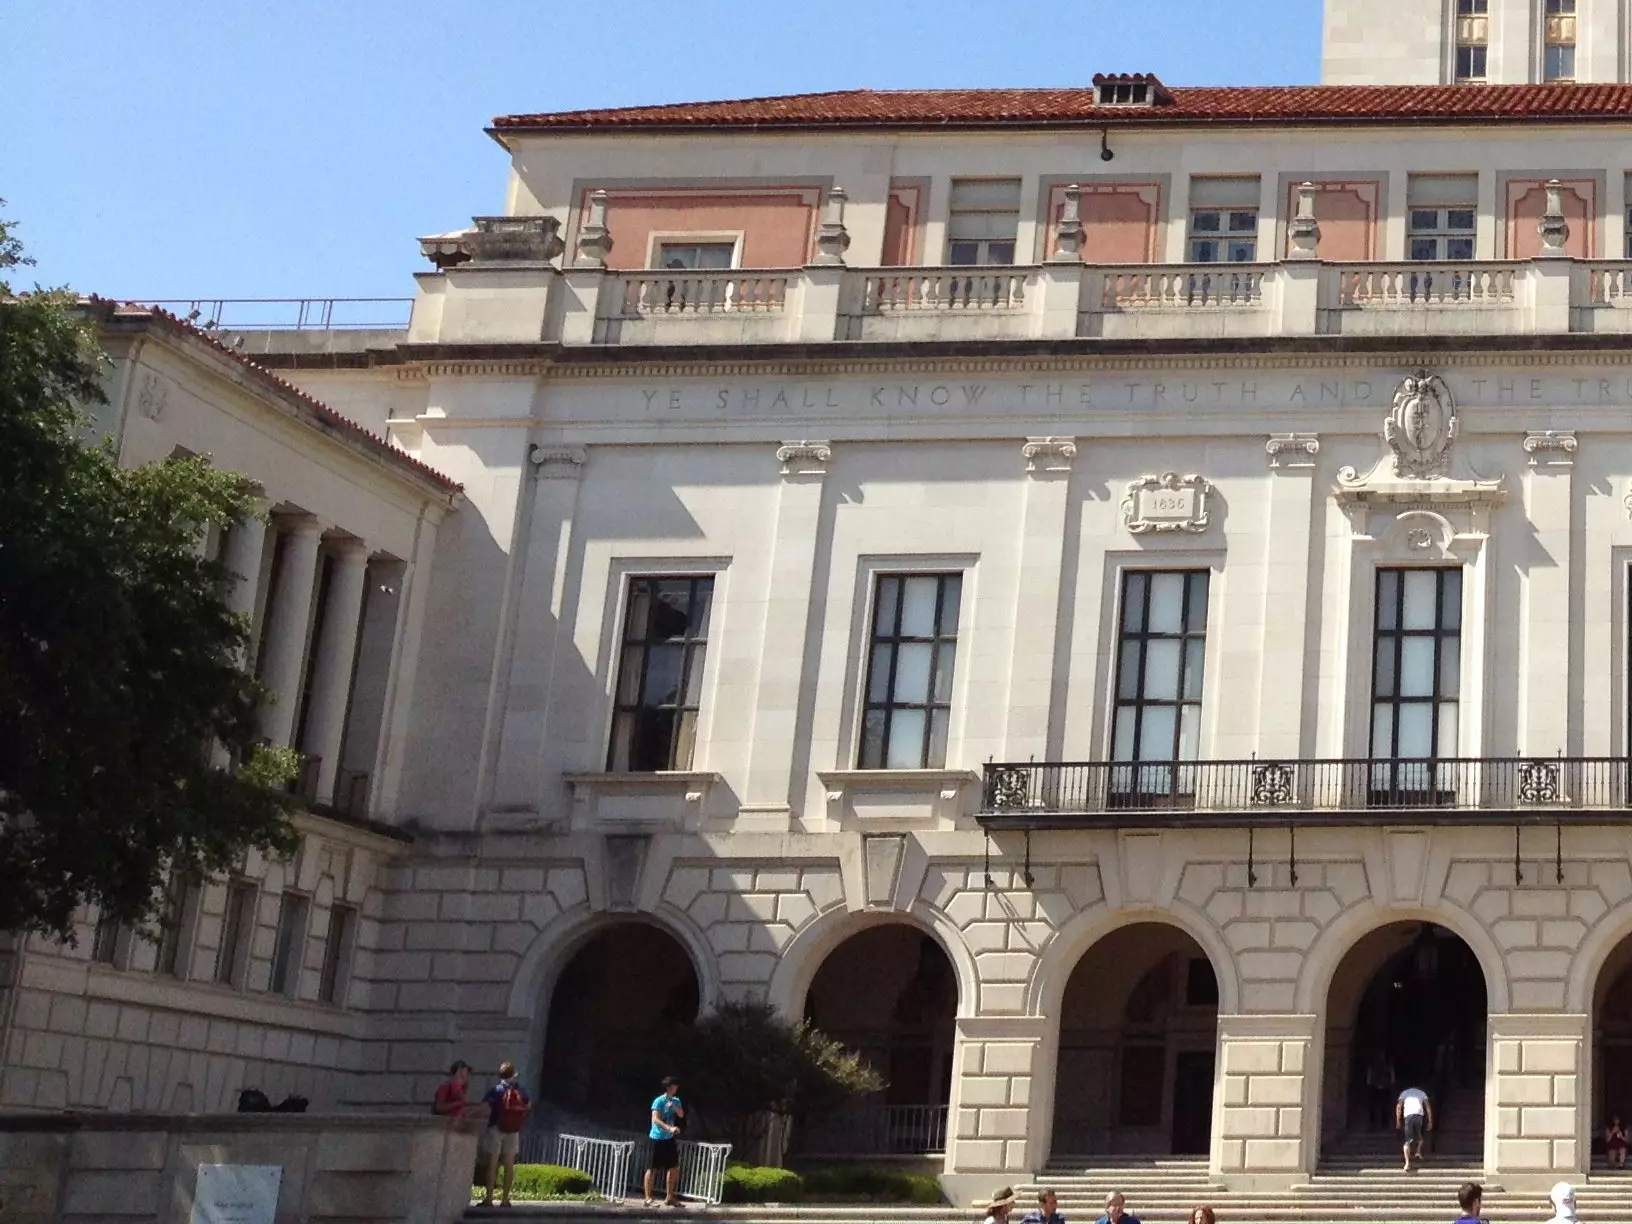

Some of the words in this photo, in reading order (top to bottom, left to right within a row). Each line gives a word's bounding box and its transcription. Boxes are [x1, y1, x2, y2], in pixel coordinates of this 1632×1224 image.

[643, 388, 682, 410] YE
[715, 388, 840, 410] SHALL
[869, 385, 987, 407] KNOW
[1018, 384, 1092, 405] THE
[1124, 382, 1258, 404] TRUTH
[1289, 381, 1373, 402] AND
[1472, 379, 1543, 399] THE
